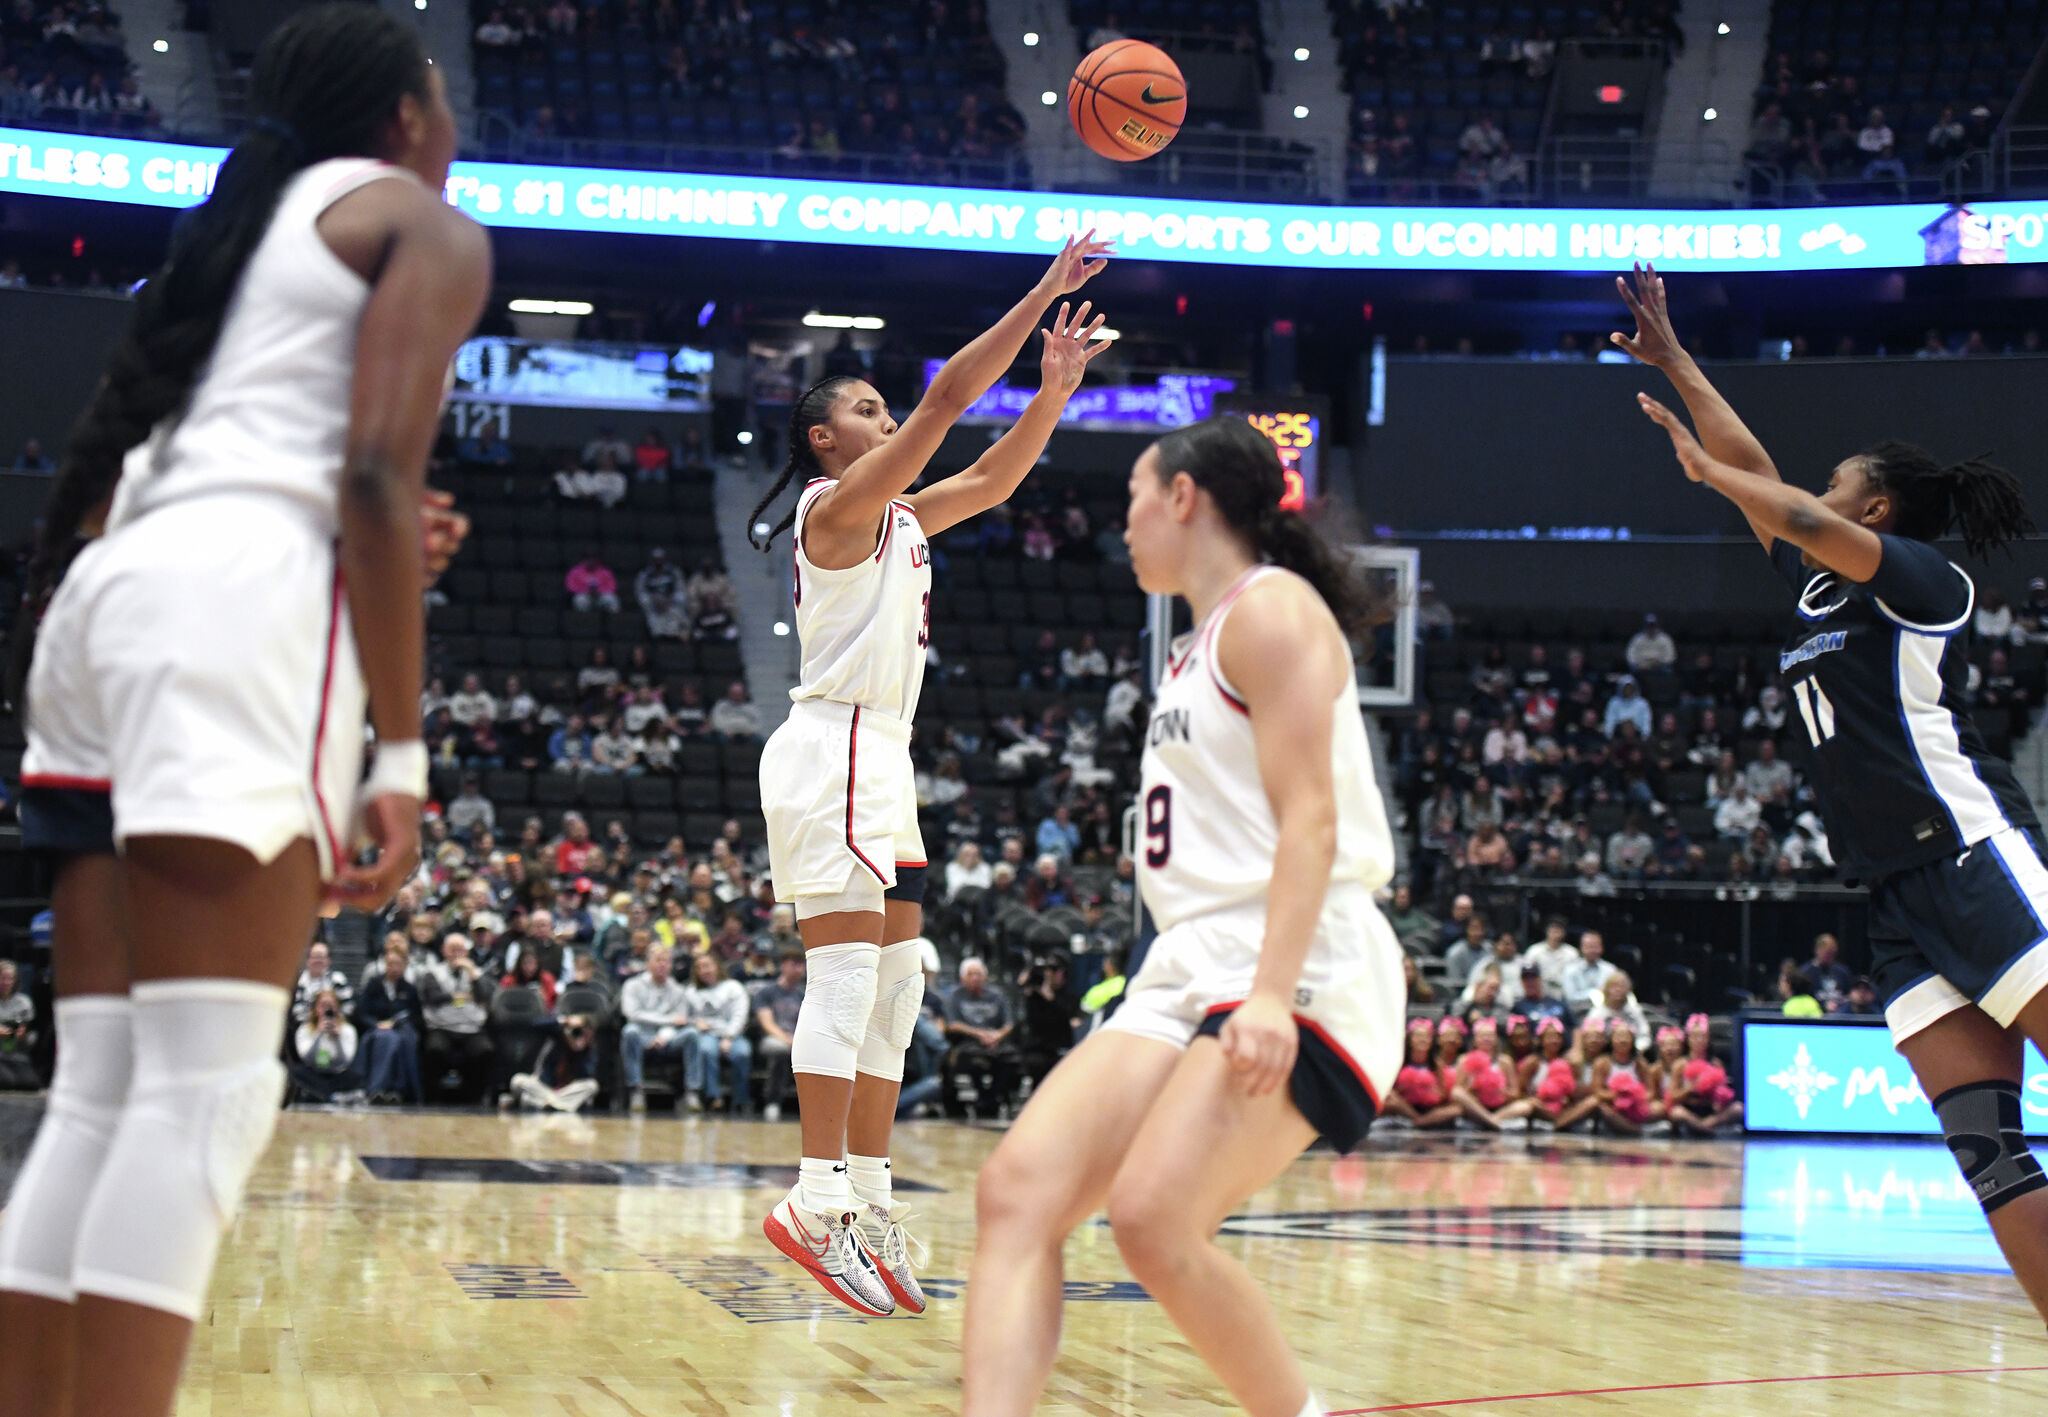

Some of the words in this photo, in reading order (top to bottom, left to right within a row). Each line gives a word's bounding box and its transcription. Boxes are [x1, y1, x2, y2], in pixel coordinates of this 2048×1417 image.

[513, 180, 564, 216] #1
[576, 182, 788, 227] CHIMNEY
[799, 194, 1025, 240] COMPANY
[1035, 207, 1271, 253] SUPPORTS
[1282, 219, 1381, 256] OUR
[1392, 222, 1557, 258] UCONN
[1570, 223, 1781, 259] HUSKIES!
[1962, 213, 2048, 250] SPO
[452, 403, 511, 439] 121
[1793, 673, 1836, 748] 11
[1146, 785, 1171, 869] 9
